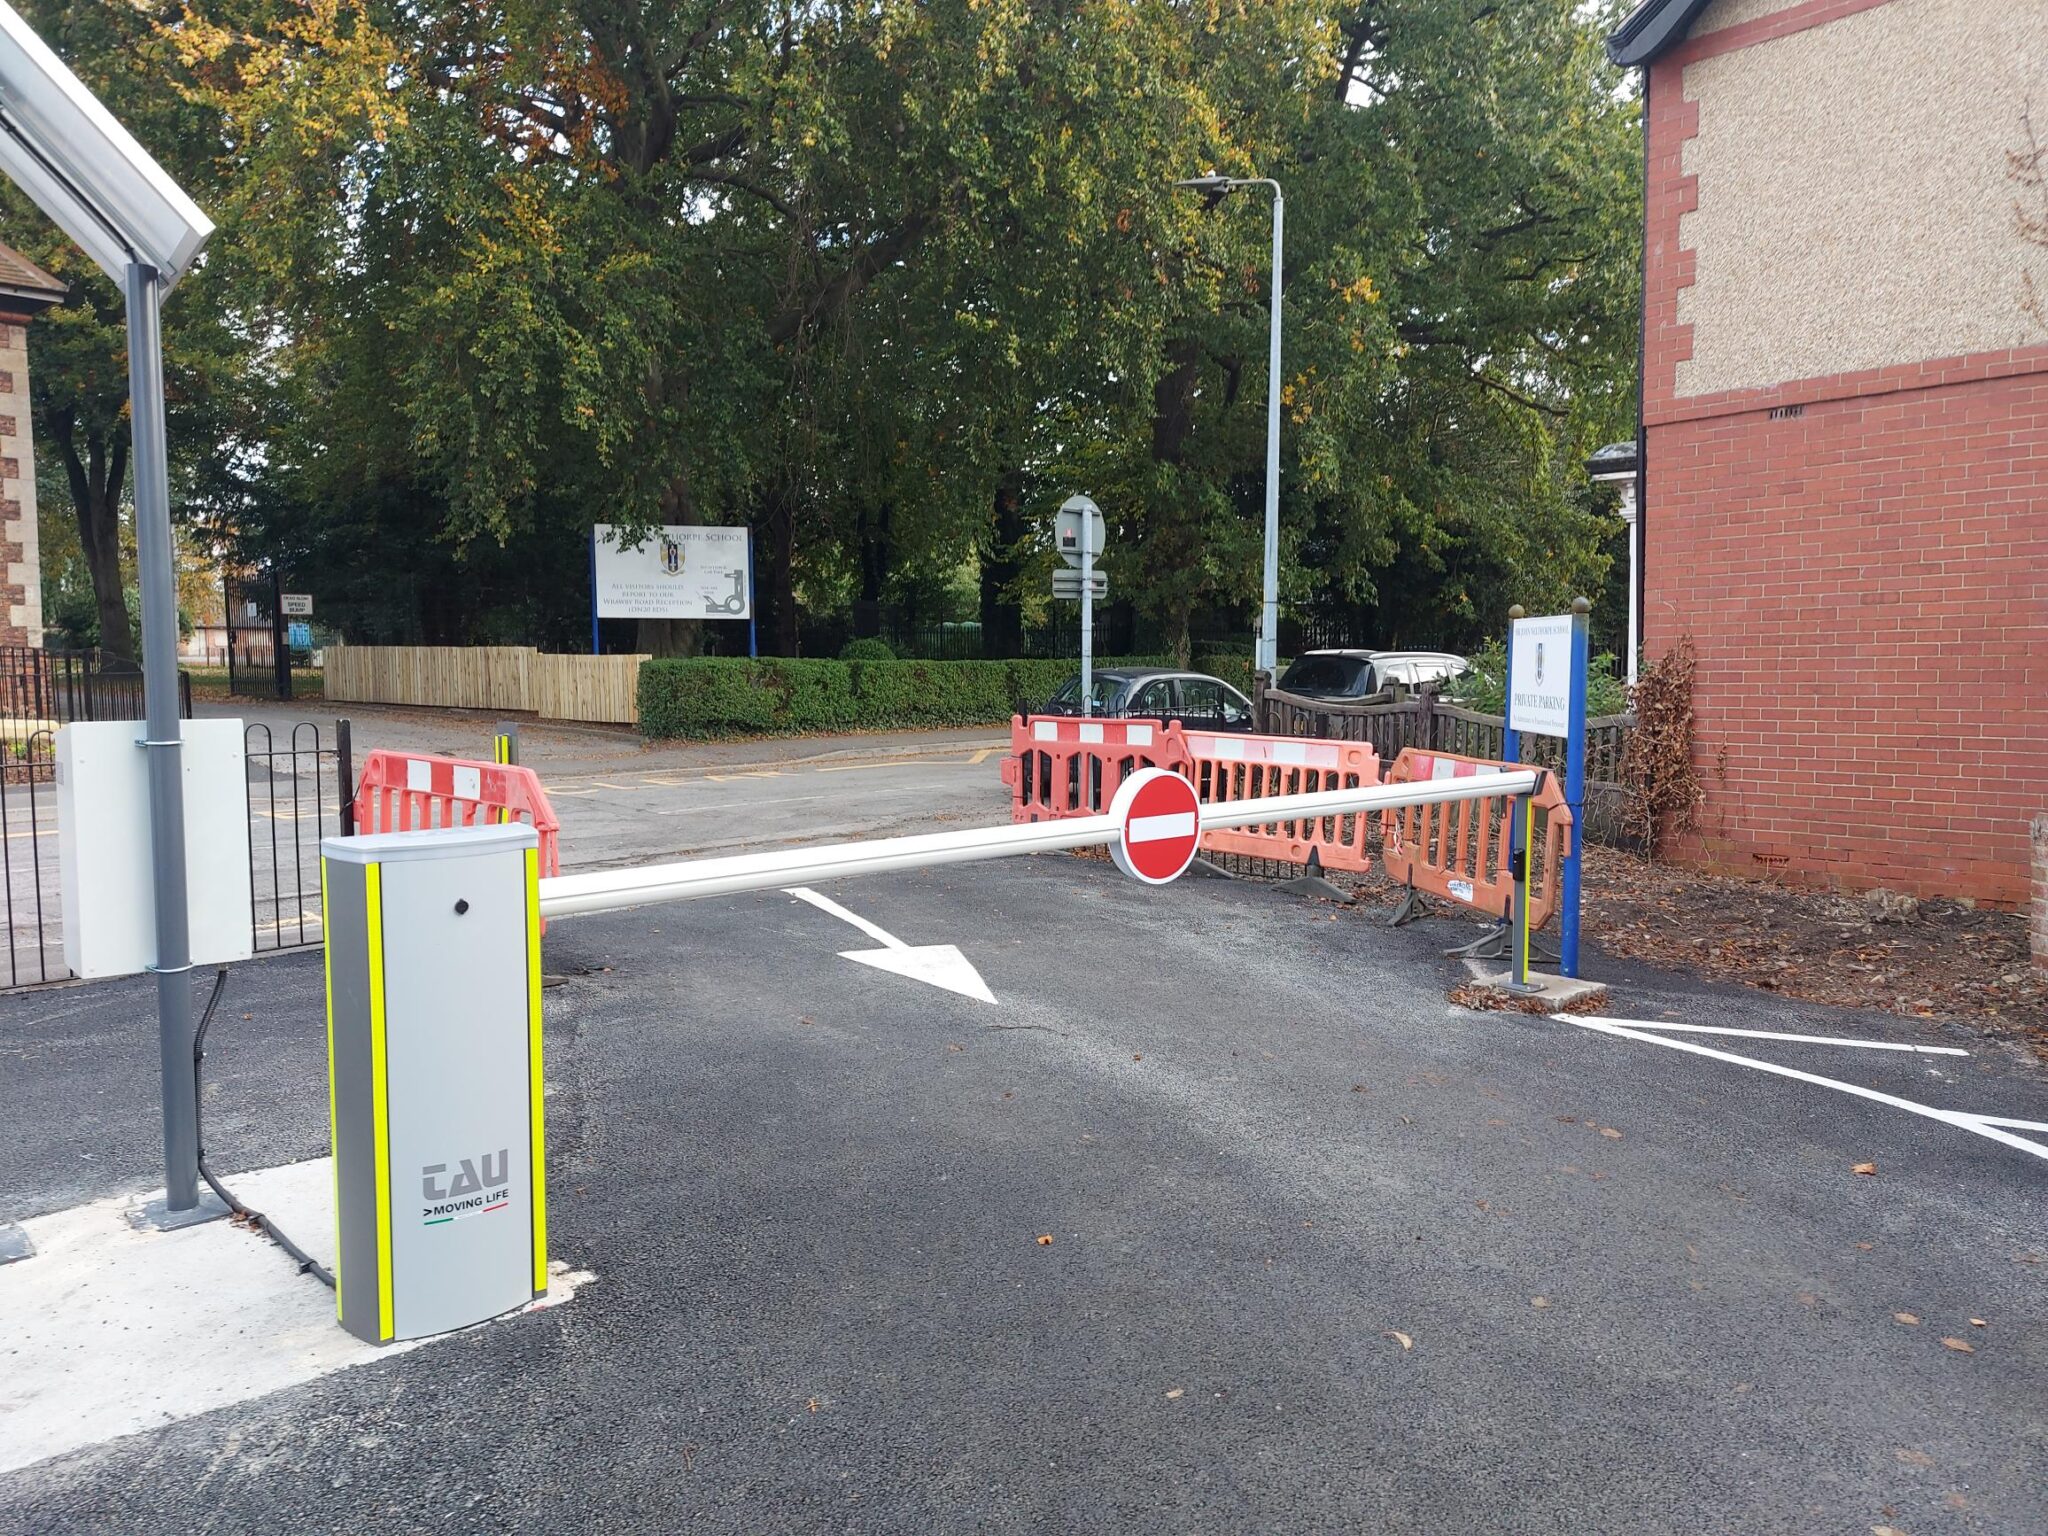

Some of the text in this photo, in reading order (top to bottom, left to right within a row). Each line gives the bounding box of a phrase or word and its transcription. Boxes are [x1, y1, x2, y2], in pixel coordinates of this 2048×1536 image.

[704, 533, 742, 542] SCHOOL
[1515, 693, 1565, 711] PRIVATE PARKING
[422, 1149, 508, 1201] TAU
[486, 1189, 509, 1203] LIFE
